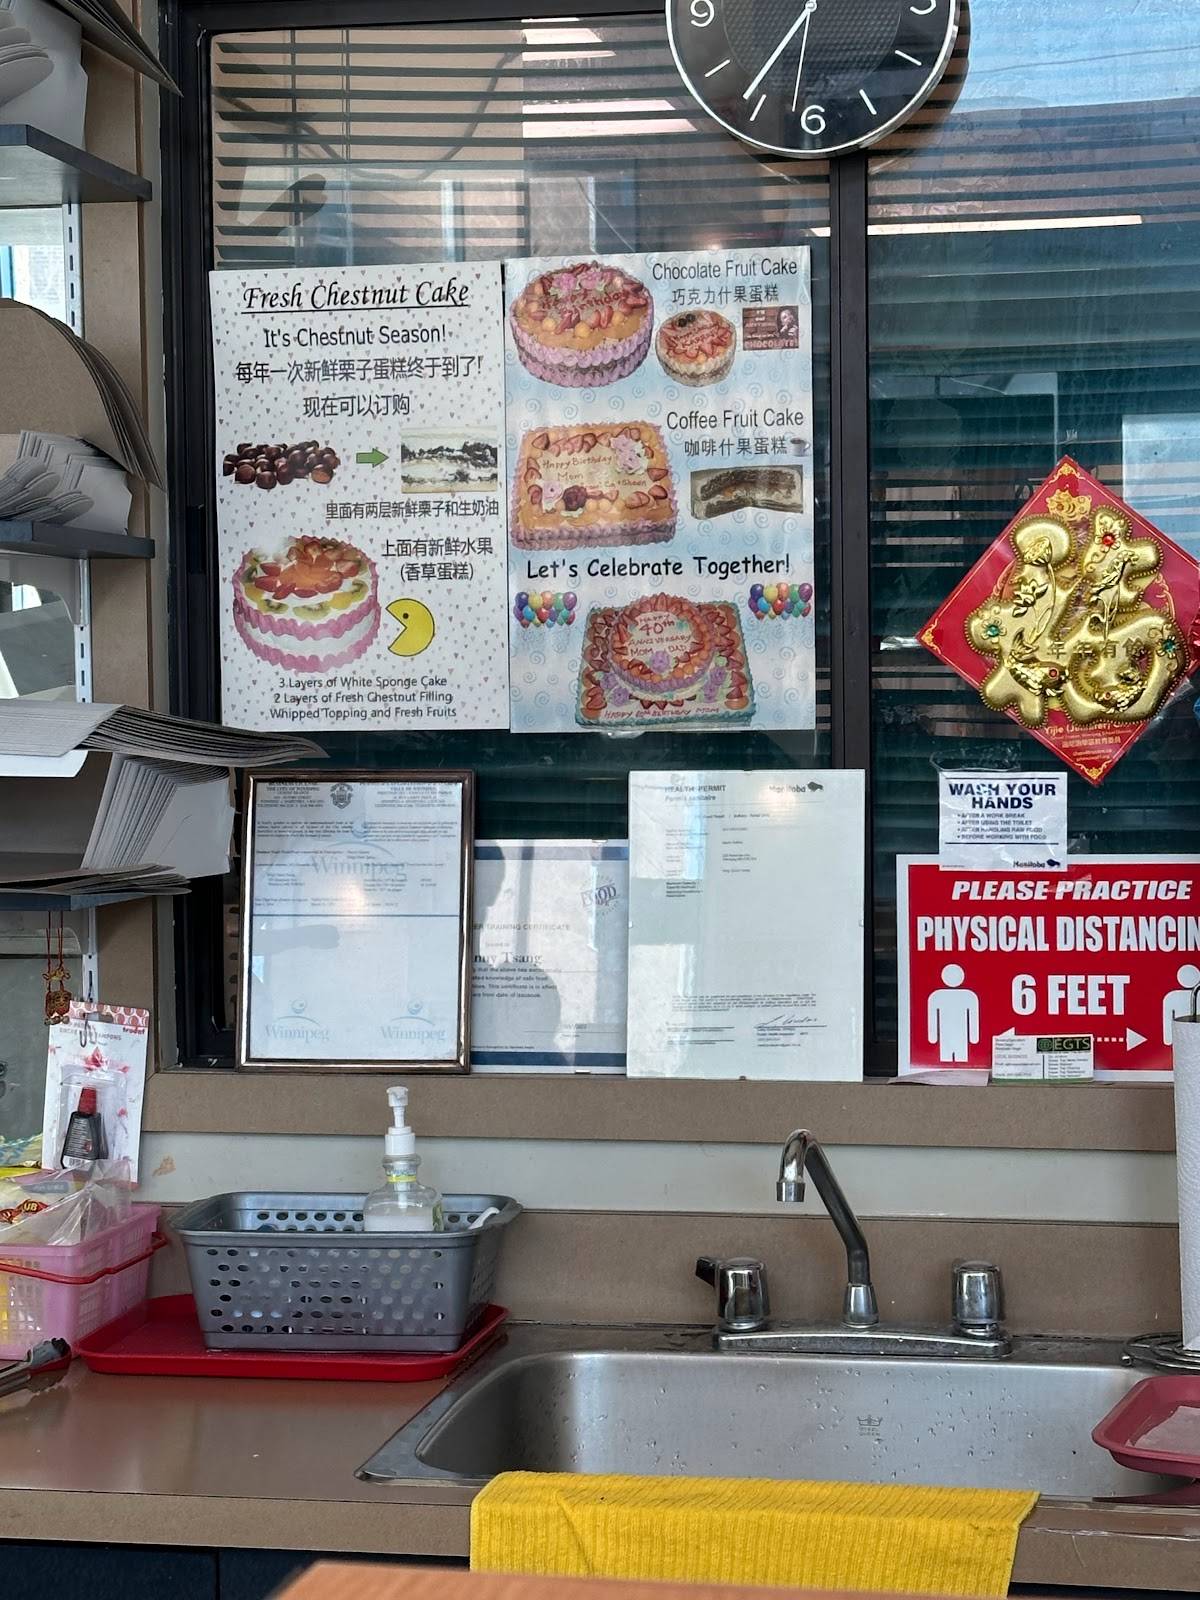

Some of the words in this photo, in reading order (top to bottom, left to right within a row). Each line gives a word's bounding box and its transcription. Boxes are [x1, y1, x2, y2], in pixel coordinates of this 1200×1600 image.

[800, 104, 826, 135] 6
[652, 263, 721, 281] Chocolate
[725, 259, 757, 278] Fruit
[761, 257, 798, 276] Cake
[243, 283, 303, 309] Fresh
[310, 281, 410, 310] Chestnut
[415, 277, 469, 307] Cake
[671, 284, 780, 306] 巧克力什果蛋糕
[263, 328, 291, 349] It's
[296, 327, 374, 347] Chestnut
[378, 324, 447, 345] Season!
[302, 394, 411, 418] 现在可以订购
[666, 410, 718, 430] Coffee
[723, 408, 759, 428] Fruit
[763, 408, 804, 427] Cake
[684, 435, 788, 457] 咖啡什果蛋糕
[381, 537, 493, 557] 上面有新鲜水果
[400, 562, 474, 583] (香草蛋糕)
[527, 559, 579, 579] Let's
[587, 556, 684, 577] Celebrate
[693, 553, 791, 580] Together!
[279, 678, 285, 688] 3
[289, 678, 323, 690] Layers
[326, 677, 337, 688] of
[340, 676, 373, 687] White
[376, 676, 418, 690] Sponge
[420, 676, 448, 687] Cake
[273, 693, 281, 704] 2
[284, 693, 318, 706] Layers
[321, 692, 332, 703] of
[335, 692, 364, 703] Fresh
[367, 691, 416, 703] Chestnut
[419, 691, 453, 705] Filling
[269, 708, 320, 721] Whipped
[322, 707, 367, 720] Topping
[370, 707, 391, 718] and
[394, 706, 423, 717] Fresh
[426, 706, 457, 717] Fruits
[697, 784, 727, 793] PERMIT
[948, 783, 1000, 796] WASH
[1006, 783, 1057, 796] YOUR
[971, 796, 1034, 809] HANDS
[310, 854, 408, 881] Winnipeg
[952, 880, 1049, 901] PLEASE
[1054, 879, 1193, 901] PRACTICE
[916, 915, 1050, 953] PHYSICAL
[1055, 915, 1200, 953] DISTANCIN
[1011, 973, 1037, 1016] 6
[1047, 974, 1131, 1016] FEET
[264, 1024, 331, 1043] Winnipeg
[379, 1025, 446, 1043] Winnipeg
[1054, 1037, 1091, 1050] EGTS
